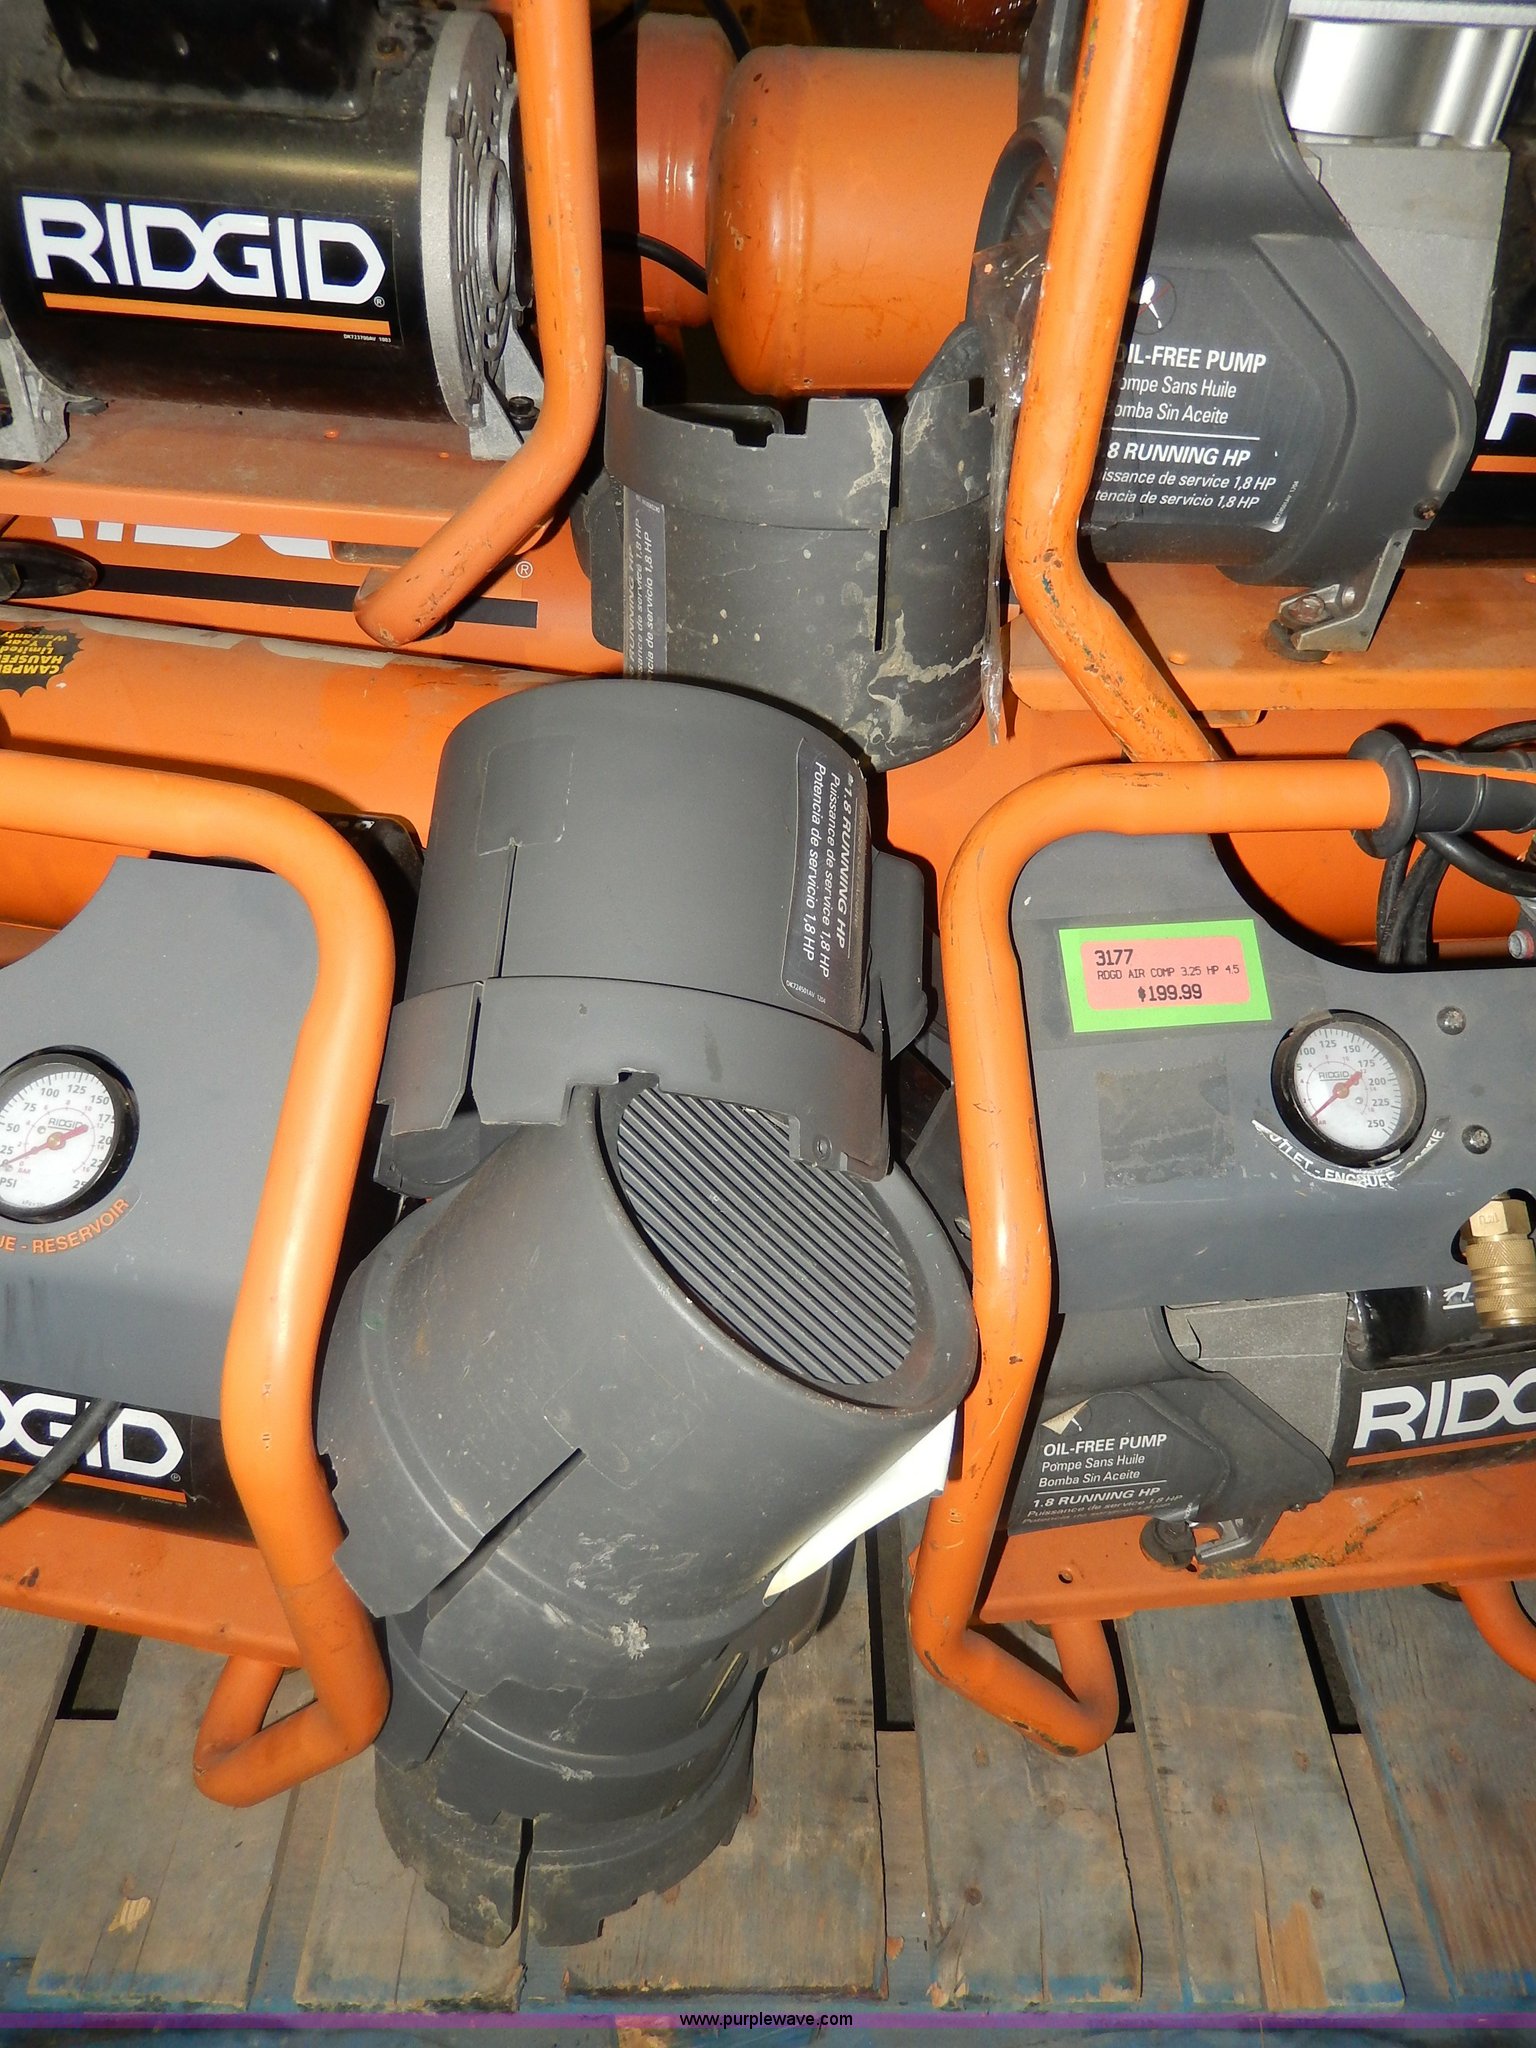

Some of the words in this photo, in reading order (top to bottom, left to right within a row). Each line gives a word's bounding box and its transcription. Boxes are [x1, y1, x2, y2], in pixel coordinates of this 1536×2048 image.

[22, 196, 385, 305] RIDGID
[1206, 349, 1266, 373] PUMP
[1120, 376, 1158, 396] ompe
[1162, 376, 1197, 395] Sans
[1201, 379, 1237, 398] Huile
[1114, 402, 1153, 419] omba
[1157, 403, 1179, 421] Sin
[1181, 404, 1229, 424] Aceite
[1123, 443, 1220, 466] RUNNING
[1222, 449, 1250, 467] HP
[1102, 467, 1155, 485] issance
[1158, 471, 1176, 486] de
[1179, 473, 1229, 489] service
[1233, 476, 1252, 491] 1,8
[1253, 477, 1276, 491] HP
[1095, 489, 1137, 504] tencia
[1139, 491, 1157, 505] de
[1159, 492, 1214, 508] servicio
[1217, 495, 1235, 509] 1,8
[1237, 497, 1260, 509] HP
[644, 531, 653, 552] HP
[645, 578, 653, 632] servicio
[1, 632, 68, 641] Warranty
[645, 633, 654, 647] de
[0, 646, 54, 655] Limited
[0, 655, 64, 664] HAUSFE
[0, 665, 60, 675] CAMPB
[811, 761, 826, 826] Potencia
[827, 772, 841, 846] Puissance
[810, 827, 820, 848] de
[827, 849, 836, 868] de
[837, 815, 851, 916] RUNNING
[806, 849, 819, 909] servicio
[822, 870, 834, 926] service
[804, 913, 816, 938] 1,8
[835, 920, 847, 949] HP
[802, 935, 815, 962] HP
[819, 930, 832, 953] 1,8
[819, 953, 830, 979] HP
[1094, 949, 1133, 966] 3177
[1128, 969, 1145, 979] AIR
[1150, 968, 1175, 978] COMP
[1181, 966, 1201, 976] 3.25
[1207, 965, 1219, 975] HP
[1225, 964, 1240, 975] 4.5
[1138, 983, 1203, 1002] $199.99
[1320, 1040, 1337, 1048] 125
[1343, 1045, 1361, 1053] 150
[1358, 1059, 1376, 1068] 175
[1319, 1070, 1350, 1079] RIDGID
[1368, 1077, 1386, 1086] 200
[40, 1088, 60, 1098] 100
[67, 1084, 87, 1094] 125
[23, 1102, 37, 1112] 75
[91, 1095, 110, 1105] 150
[1372, 1098, 1390, 1106] 225
[6, 1123, 20, 1133] 50
[1367, 1119, 1385, 1128] 250
[0, 1145, 14, 1155] 25
[98, 1136, 113, 1145] 20
[1256, 1122, 1314, 1169] UTLET
[0, 1177, 17, 1188] PSI
[72, 1180, 87, 1189] 25
[32, 1198, 129, 1253] RESERVOIR
[1043, 1439, 1115, 1457] OIL-FREE
[1119, 1433, 1167, 1450] PUMP
[1042, 1459, 1082, 1473] Pompe
[1085, 1457, 1113, 1469] Sans
[1116, 1454, 1145, 1466] Huile
[1038, 1474, 1079, 1488] Bomba
[1082, 1472, 1100, 1483] Sin
[1102, 1469, 1140, 1482] Aceite
[1033, 1498, 1054, 1508] 1.8
[1057, 1489, 1135, 1506] RUNNING
[1138, 1487, 1161, 1497] HP
